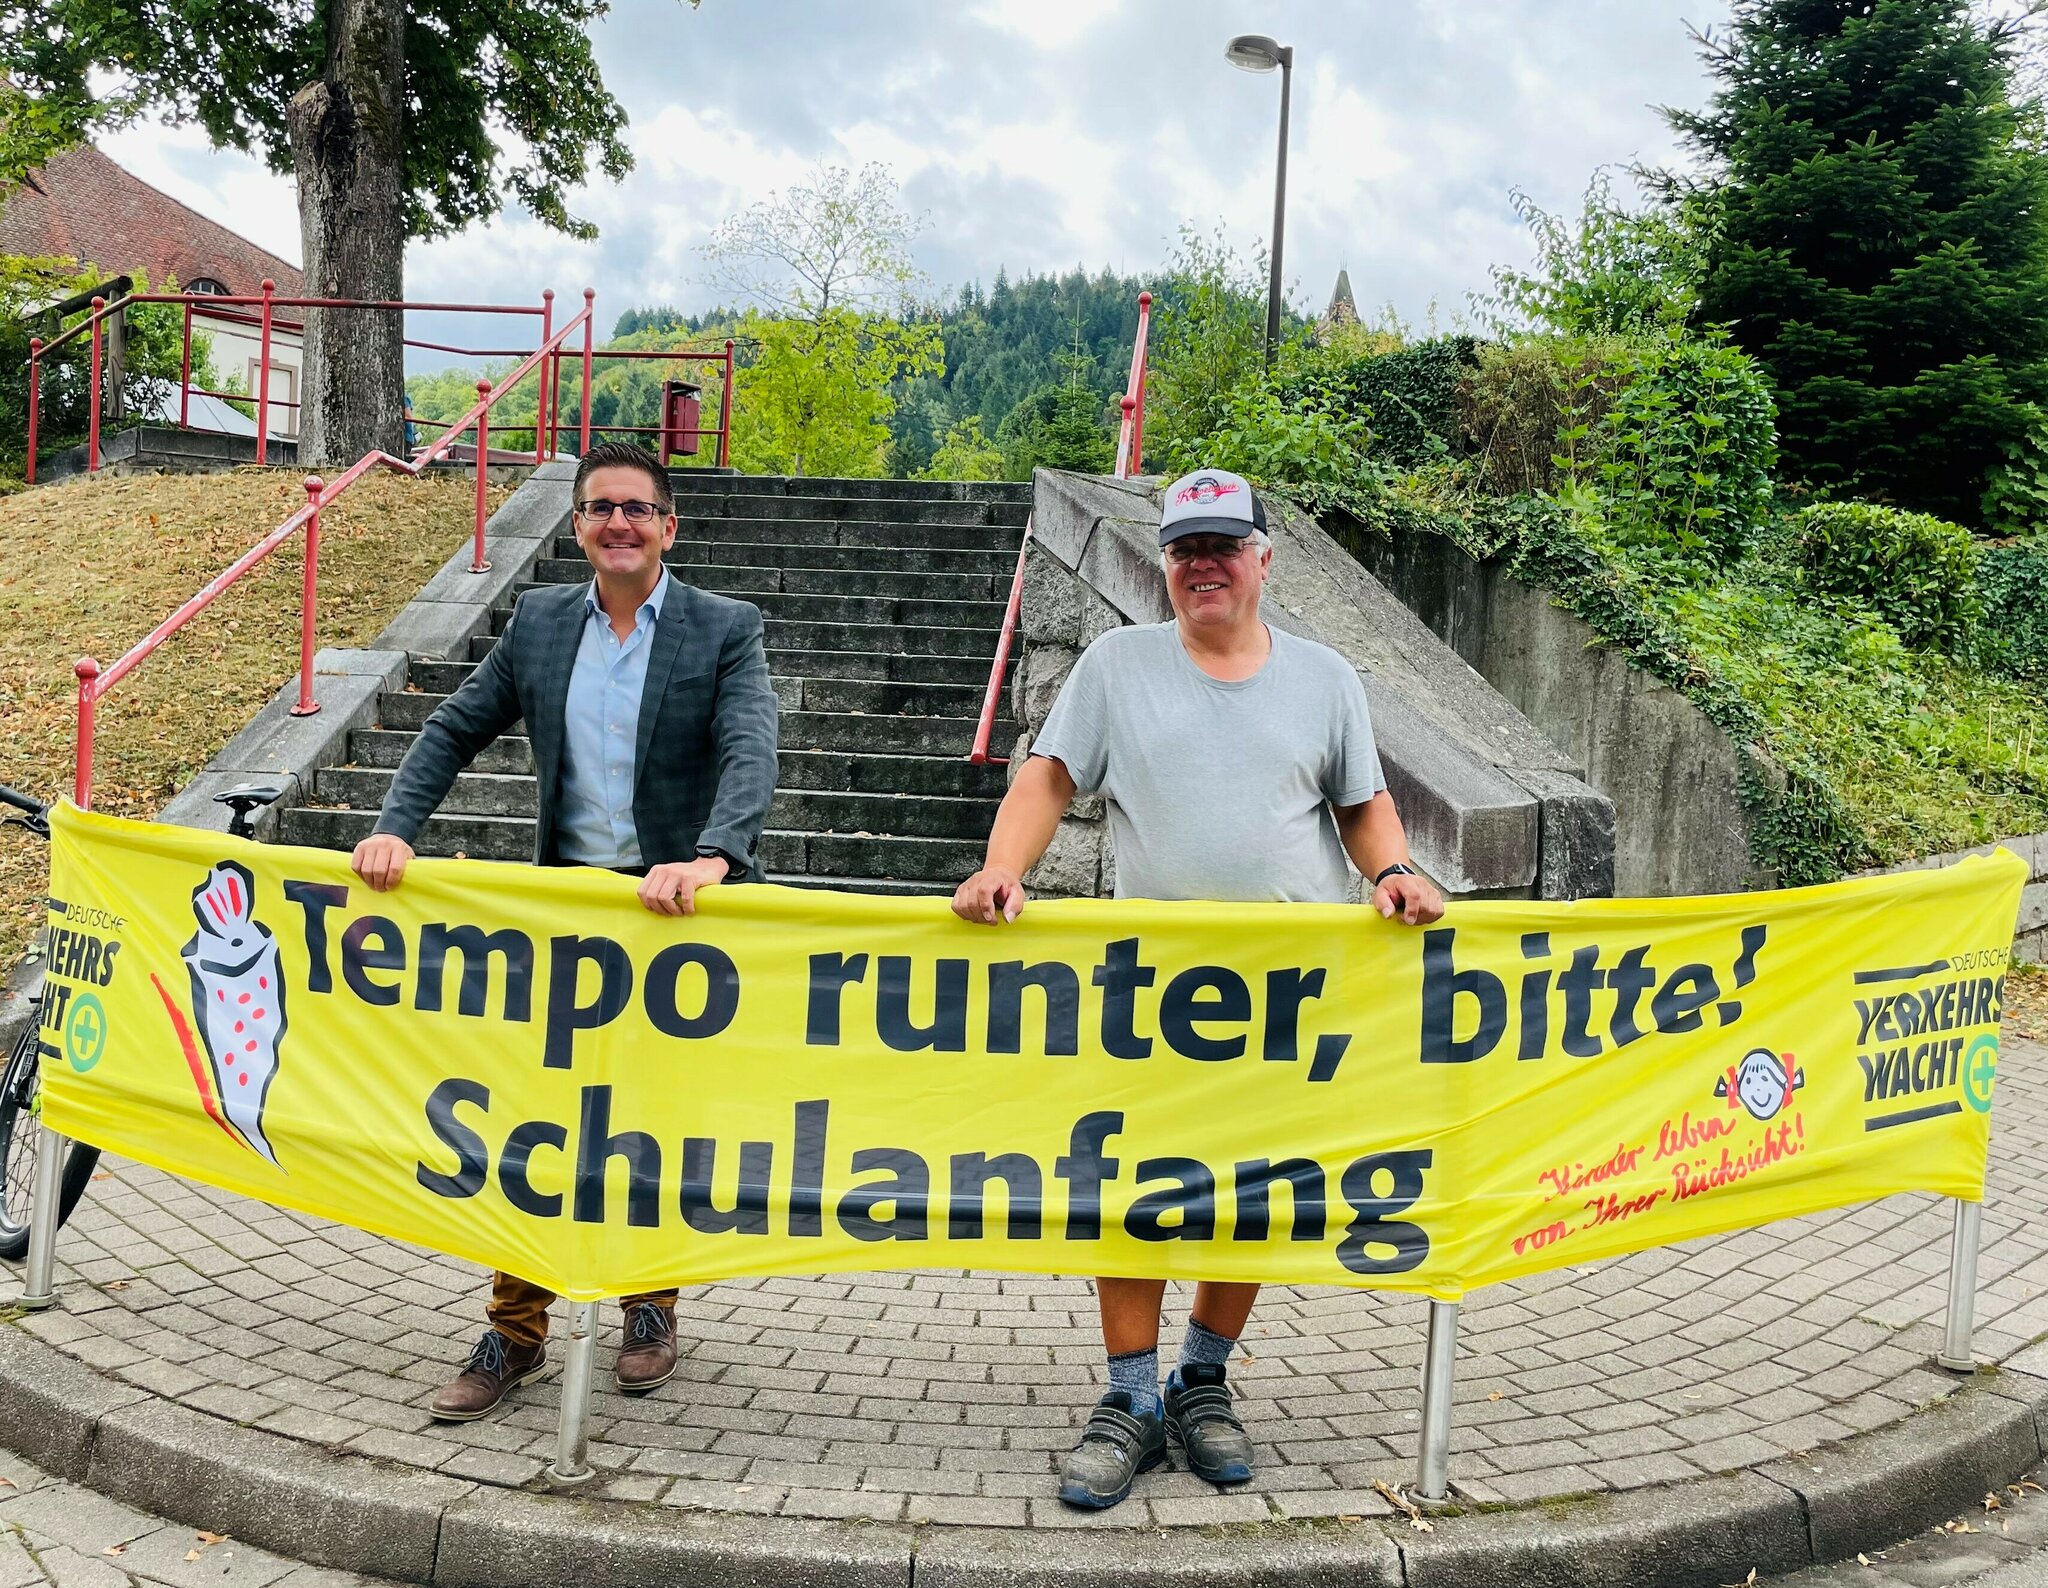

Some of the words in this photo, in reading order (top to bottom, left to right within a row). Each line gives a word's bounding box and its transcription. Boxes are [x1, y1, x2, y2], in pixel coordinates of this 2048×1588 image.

[66, 903, 128, 933] DEUTSCHE
[283, 879, 740, 1070] Tempo
[805, 937, 1353, 1082] runter,
[1420, 924, 1767, 1064] bitte!
[1951, 945, 2009, 972] DEUTSCHE
[41, 980, 72, 1032] HT
[1853, 974, 2005, 1046] VERKEHRS
[1857, 1037, 1964, 1102] WACHT
[416, 1077, 1433, 1275] Schulanfang
[1511, 1220, 1575, 1256] von
[1583, 1186, 1667, 1230] Ihrer
[1671, 1112, 1806, 1203] Rücksicht!
[1538, 1143, 1645, 1203] Kinder
[1653, 1112, 1736, 1162] leben
